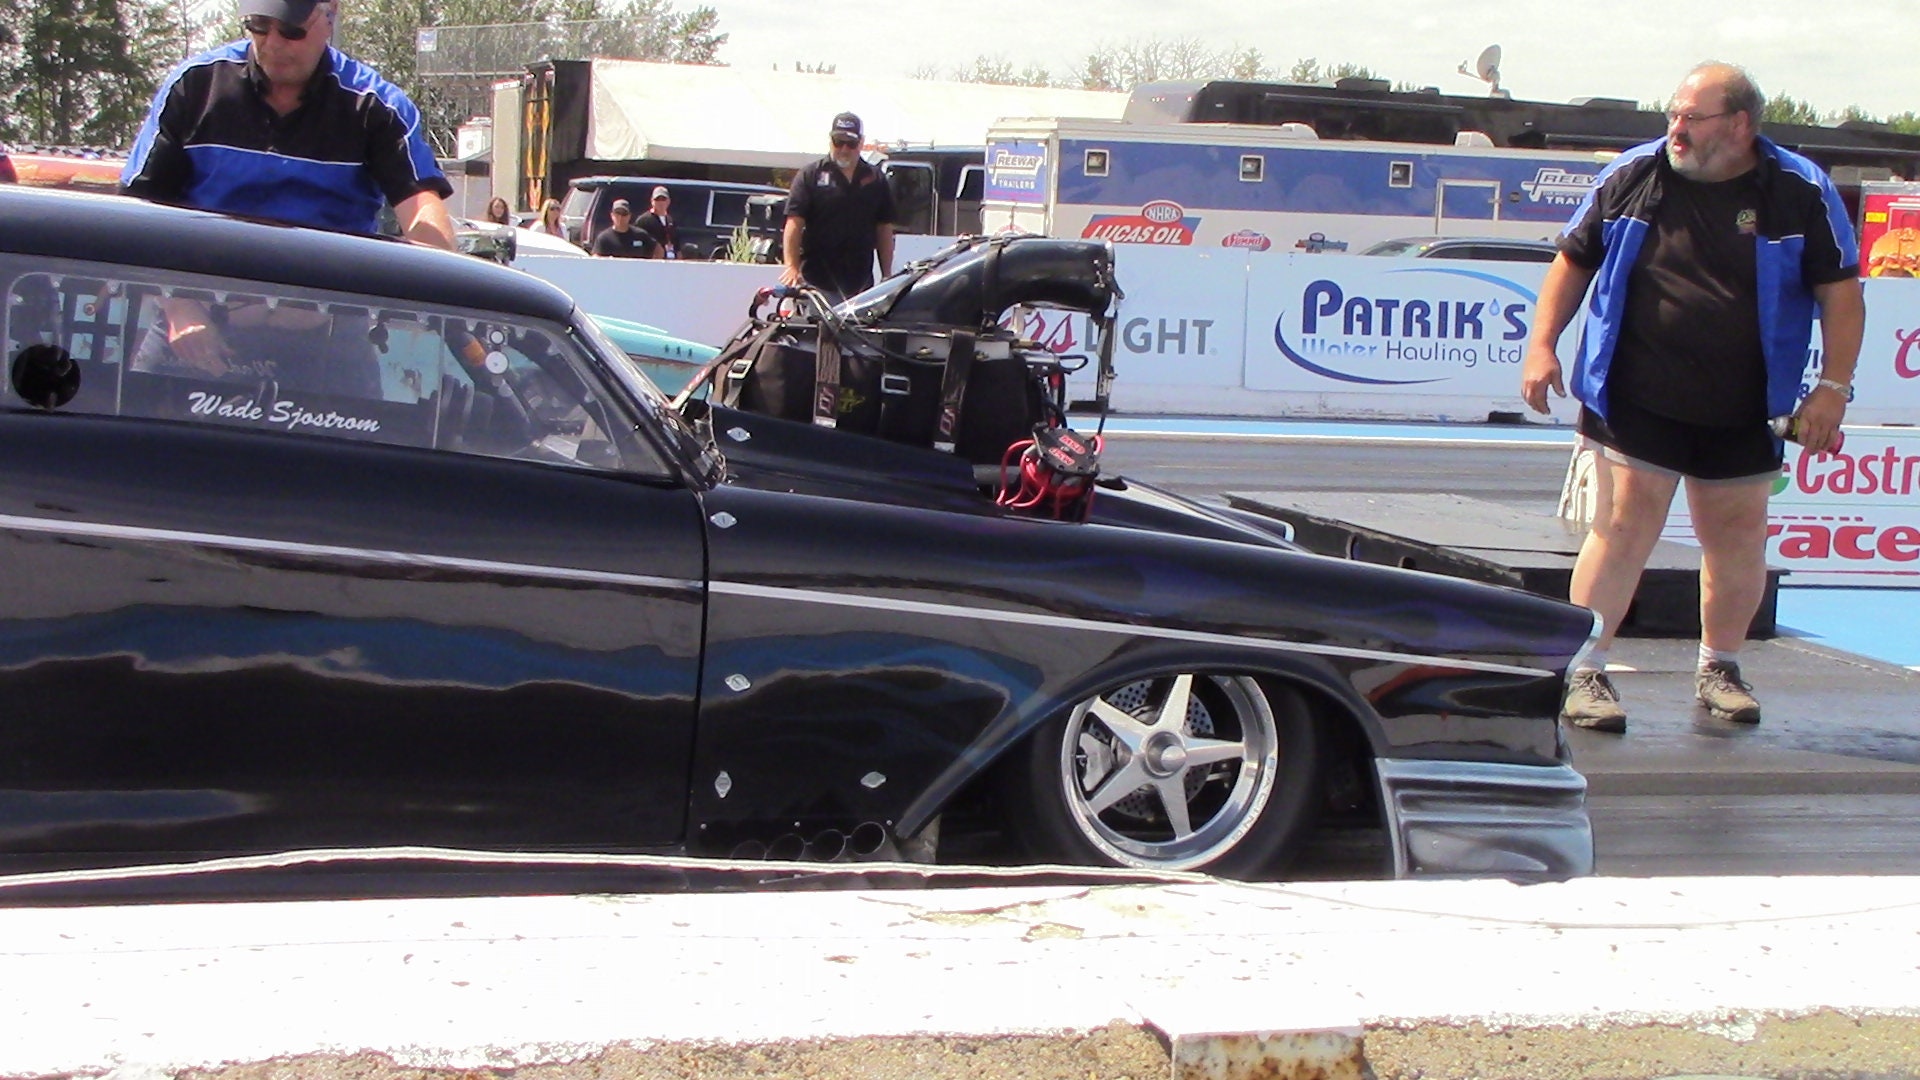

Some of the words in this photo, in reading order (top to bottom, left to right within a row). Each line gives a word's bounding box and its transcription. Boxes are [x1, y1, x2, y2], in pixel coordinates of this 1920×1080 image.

[1000, 179, 1035, 190] TRAILERS
[1546, 196, 1580, 205] TRAI
[1148, 206, 1177, 222] NHRA
[1090, 225, 1155, 243] LUCAS
[1153, 227, 1183, 244] OIL
[1084, 316, 1215, 355] LGHT
[1302, 338, 1377, 358] Water
[1386, 341, 1478, 368] Hauling
[1488, 344, 1523, 364] Ltd
[188, 391, 264, 421] Wade
[268, 400, 381, 433] Sjostrom
[1796, 446, 1920, 495] Castr
